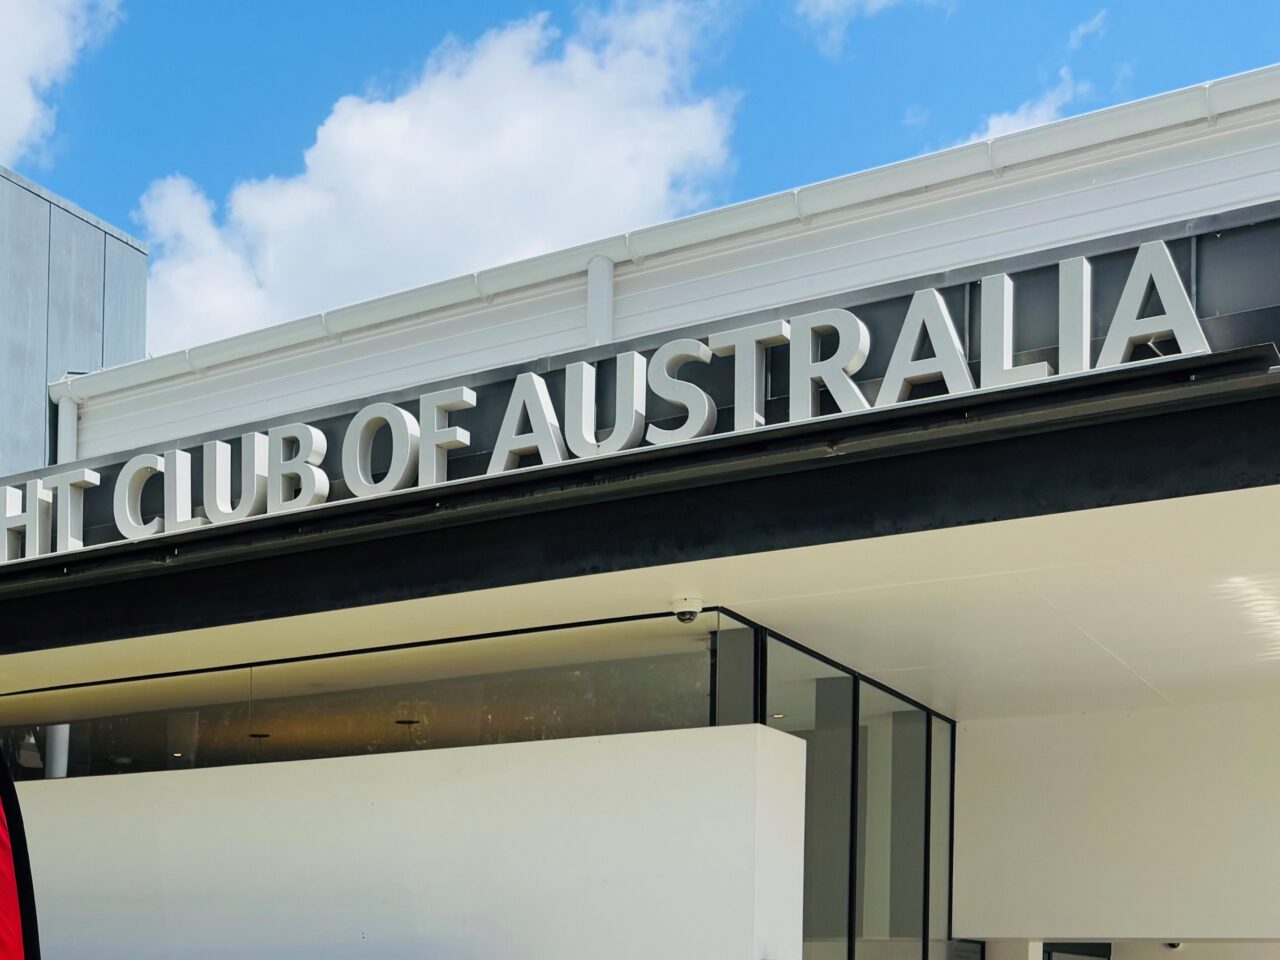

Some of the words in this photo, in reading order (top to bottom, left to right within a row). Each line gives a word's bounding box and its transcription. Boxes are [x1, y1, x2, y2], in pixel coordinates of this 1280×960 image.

[113, 422, 330, 540] CLUB
[341, 385, 477, 498] OF
[488, 239, 1212, 474] AUSTRALIA
